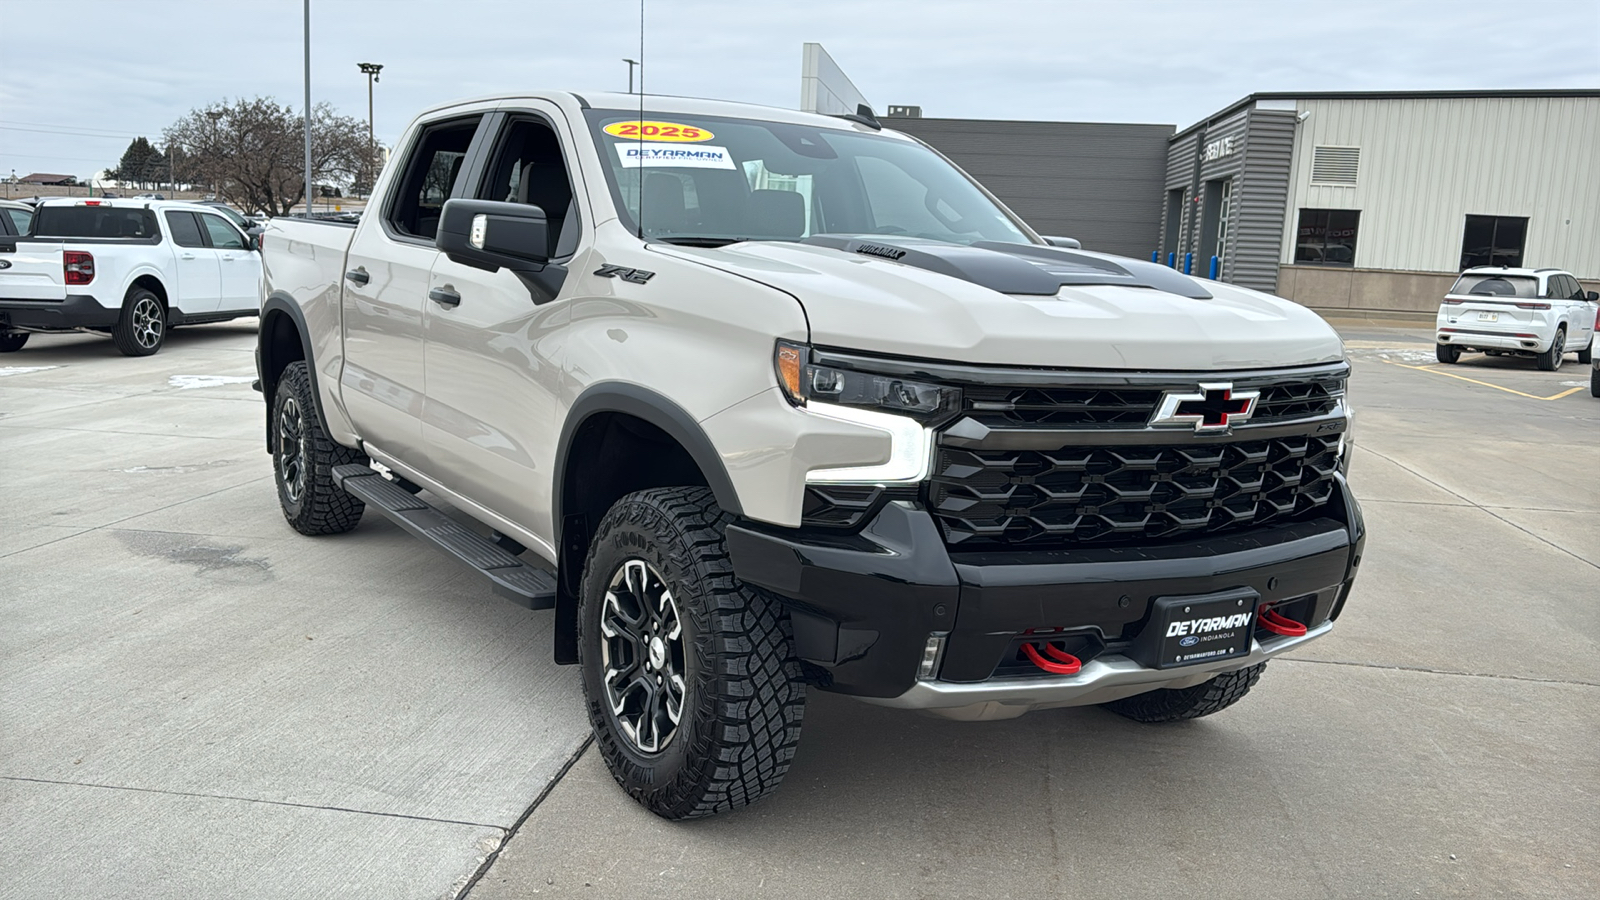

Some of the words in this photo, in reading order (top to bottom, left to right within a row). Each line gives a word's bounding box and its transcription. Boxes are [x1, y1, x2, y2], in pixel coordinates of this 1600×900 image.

[618, 124, 700, 139] 2025
[626, 149, 723, 159] DEYARMAN
[593, 263, 656, 285] ZR2
[1165, 612, 1252, 637] DEYARMAN
[1200, 632, 1235, 642] INDIANOLA
[1183, 649, 1227, 661] DEYARMANFORD.COM
